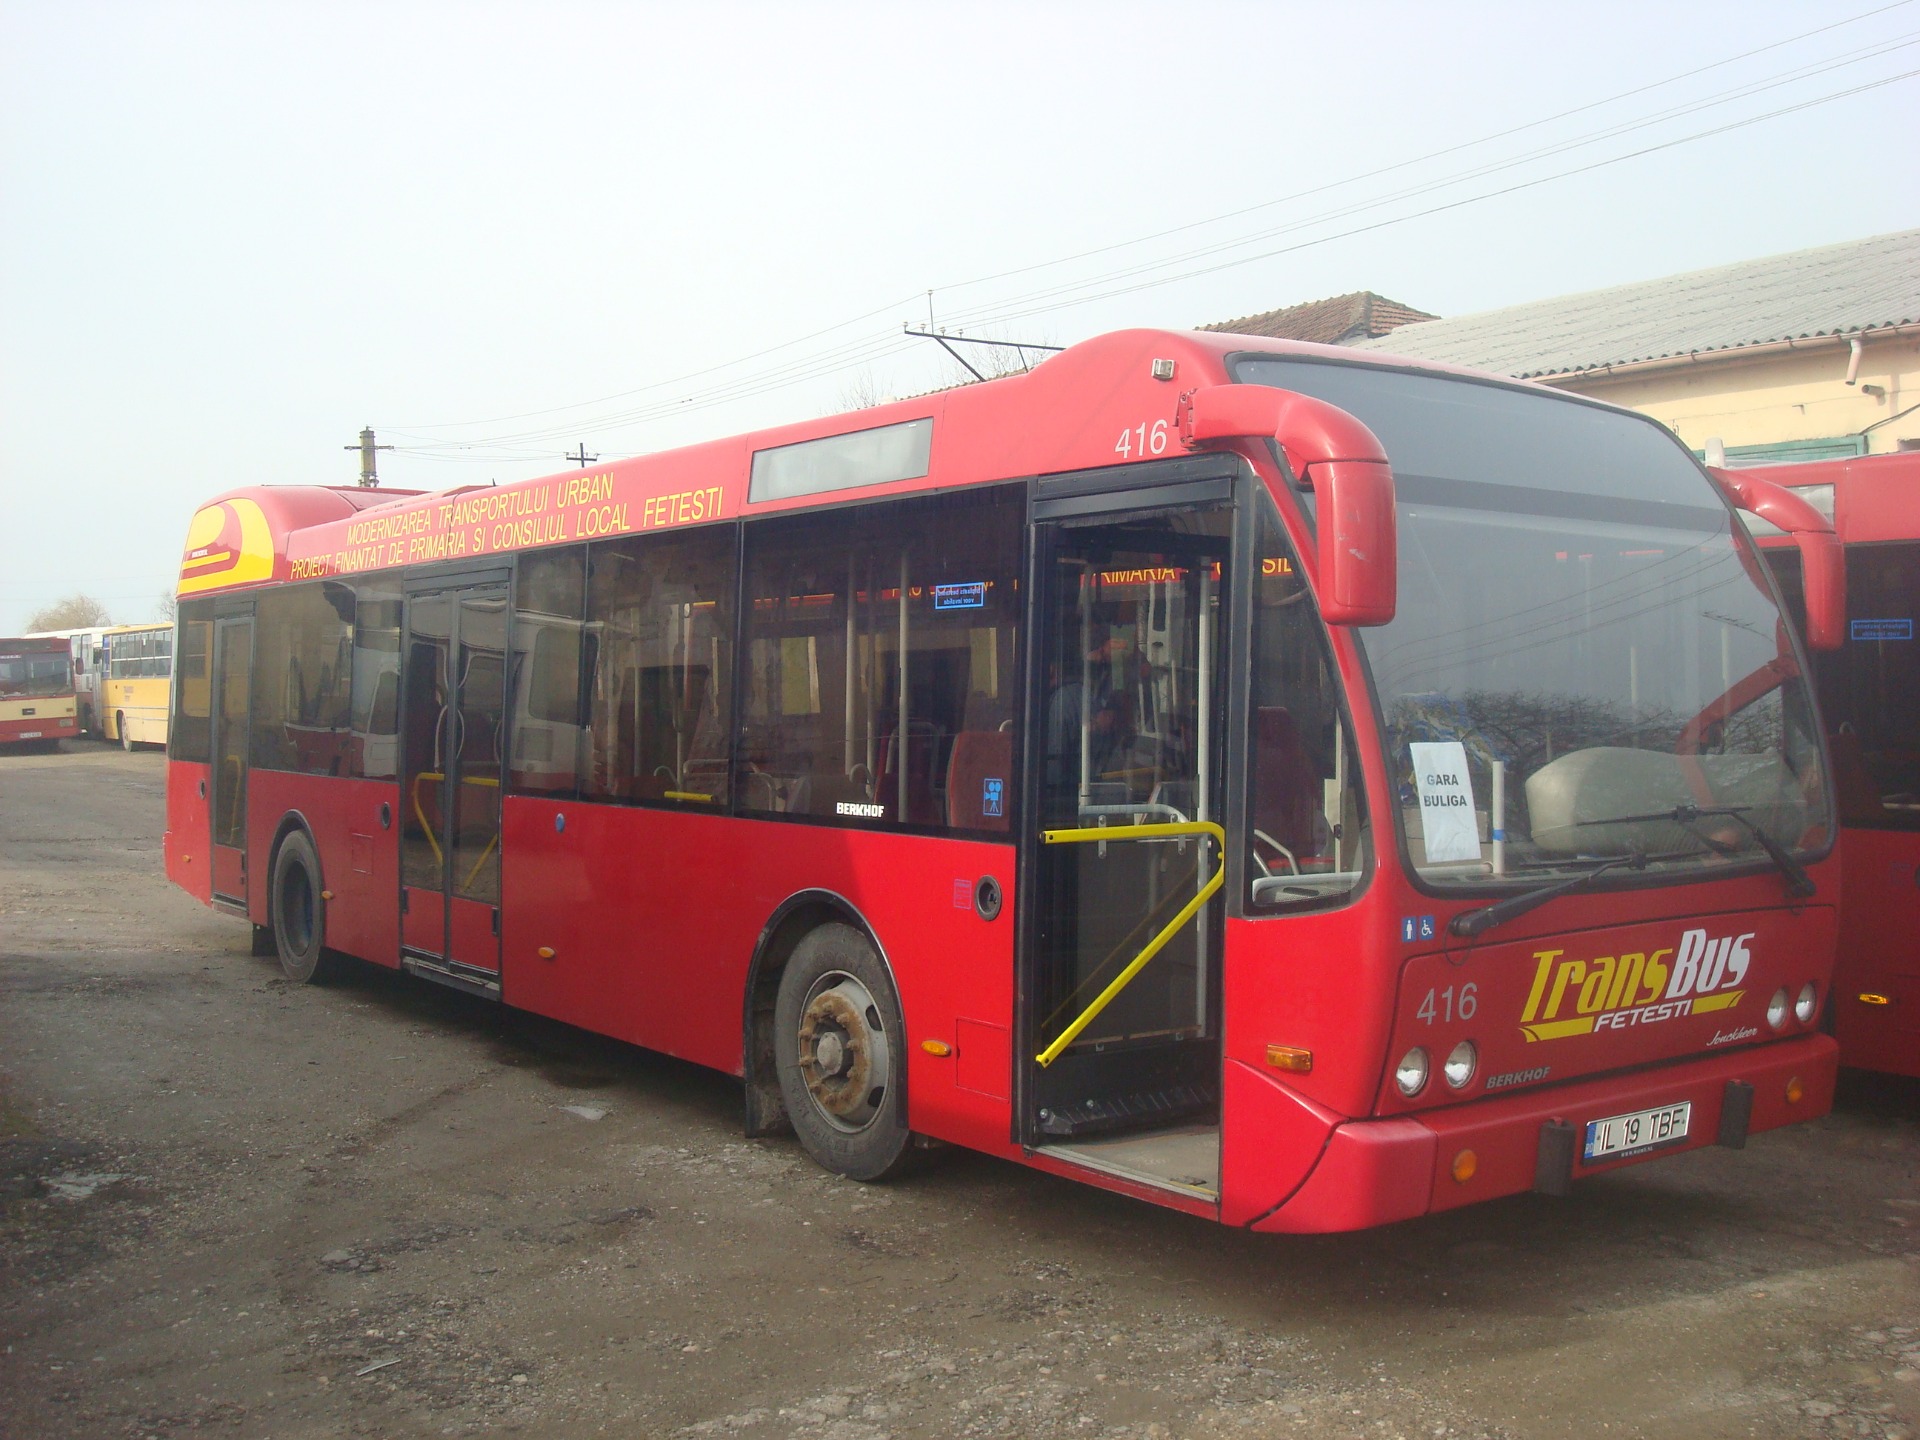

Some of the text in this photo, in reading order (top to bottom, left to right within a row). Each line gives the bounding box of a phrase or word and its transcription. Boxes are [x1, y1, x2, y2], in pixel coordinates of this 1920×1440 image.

[1114, 419, 1168, 459] 416
[346, 472, 614, 547] MODERNIZAREA TRANSPORTULUI URBAN
[290, 486, 723, 580] PROIECT FINANTAT DE PRIMARIA SI CONSILIUL LOCAL FETESTI
[1426, 774, 1459, 786] GARA
[836, 802, 885, 818] BERKHOF
[1423, 795, 1467, 807] BULIGA
[1416, 982, 1478, 1025] 416
[1593, 1000, 1693, 1032] FETESTI
[1486, 1066, 1551, 1089] BERKHOF
[1600, 1122, 1615, 1150] IL
[1623, 1117, 1640, 1146] 19
[1649, 1107, 1684, 1140] TBF
